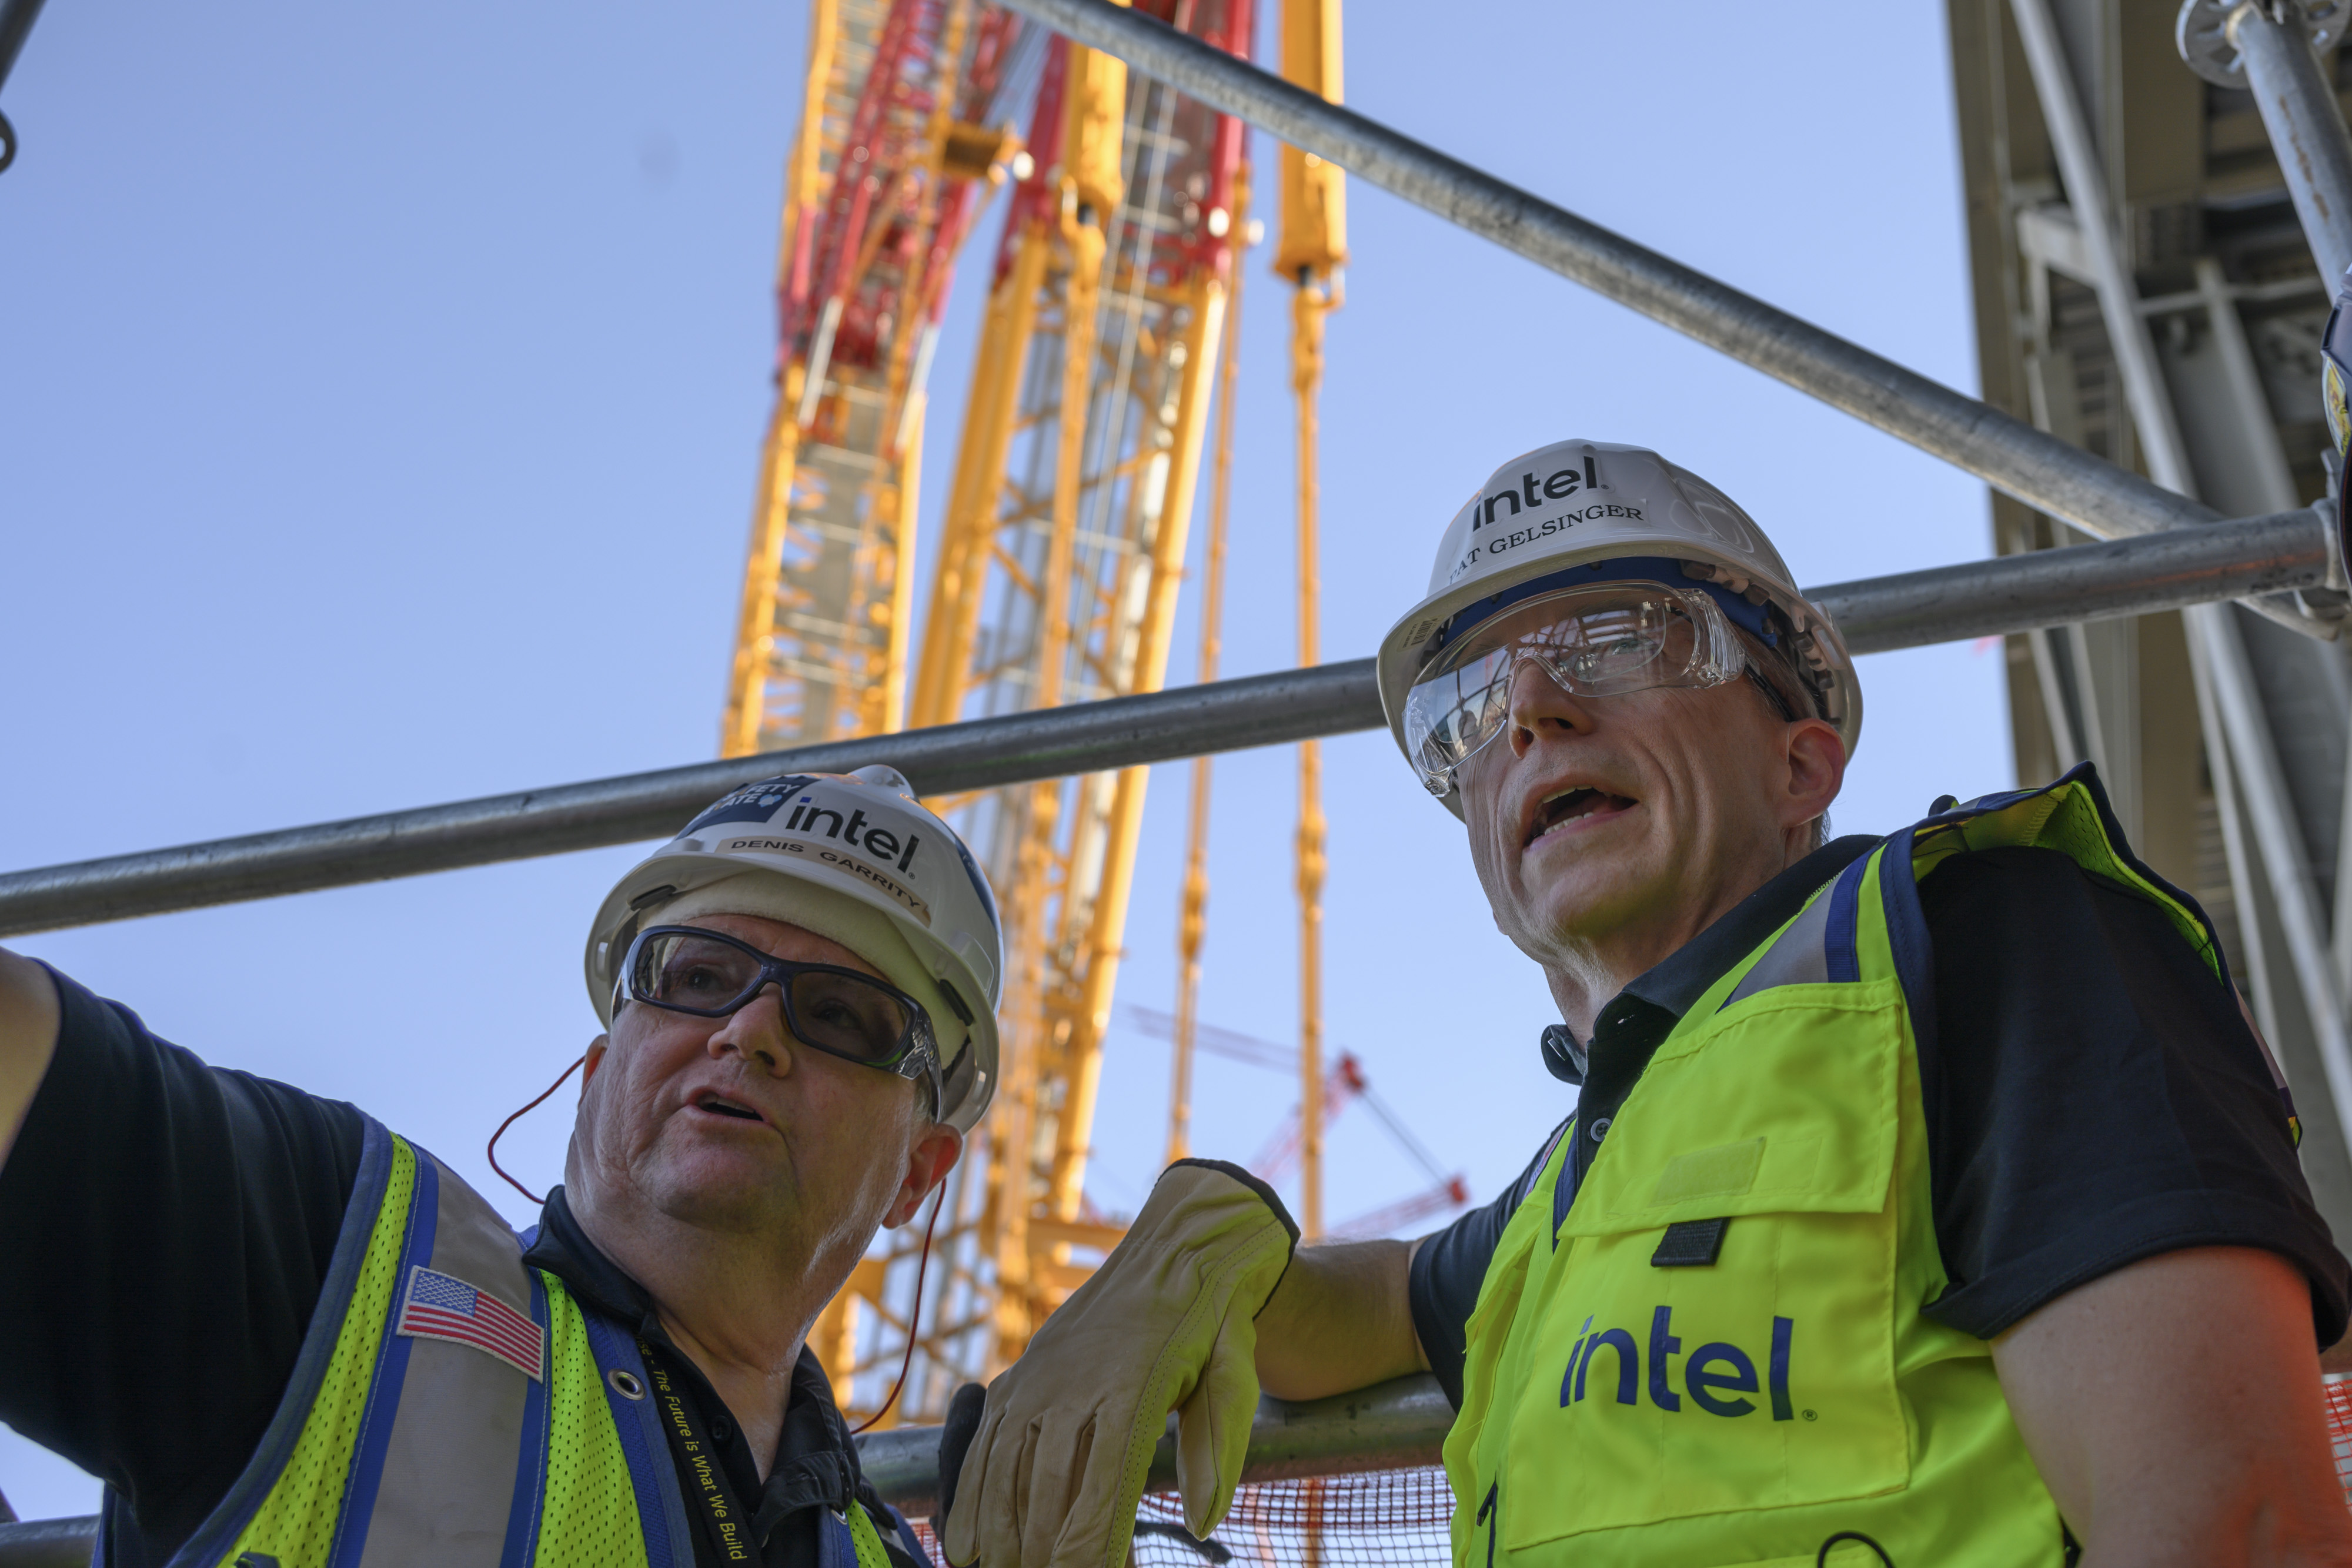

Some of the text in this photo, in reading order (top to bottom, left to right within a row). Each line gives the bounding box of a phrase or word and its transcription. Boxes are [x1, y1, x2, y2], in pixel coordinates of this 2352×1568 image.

[1472, 456, 1598, 532] intel
[1489, 504, 1645, 554] GELSINGER
[786, 797, 920, 873] intel
[731, 840, 920, 907] DENIS GARRITY
[653, 1369, 671, 1392] The
[1560, 1305, 1793, 1421] intel
[665, 1396, 691, 1437] Future
[684, 1441, 699, 1452] is
[691, 1455, 717, 1492] What
[709, 1495, 729, 1519] We
[720, 1522, 747, 1560] Build
